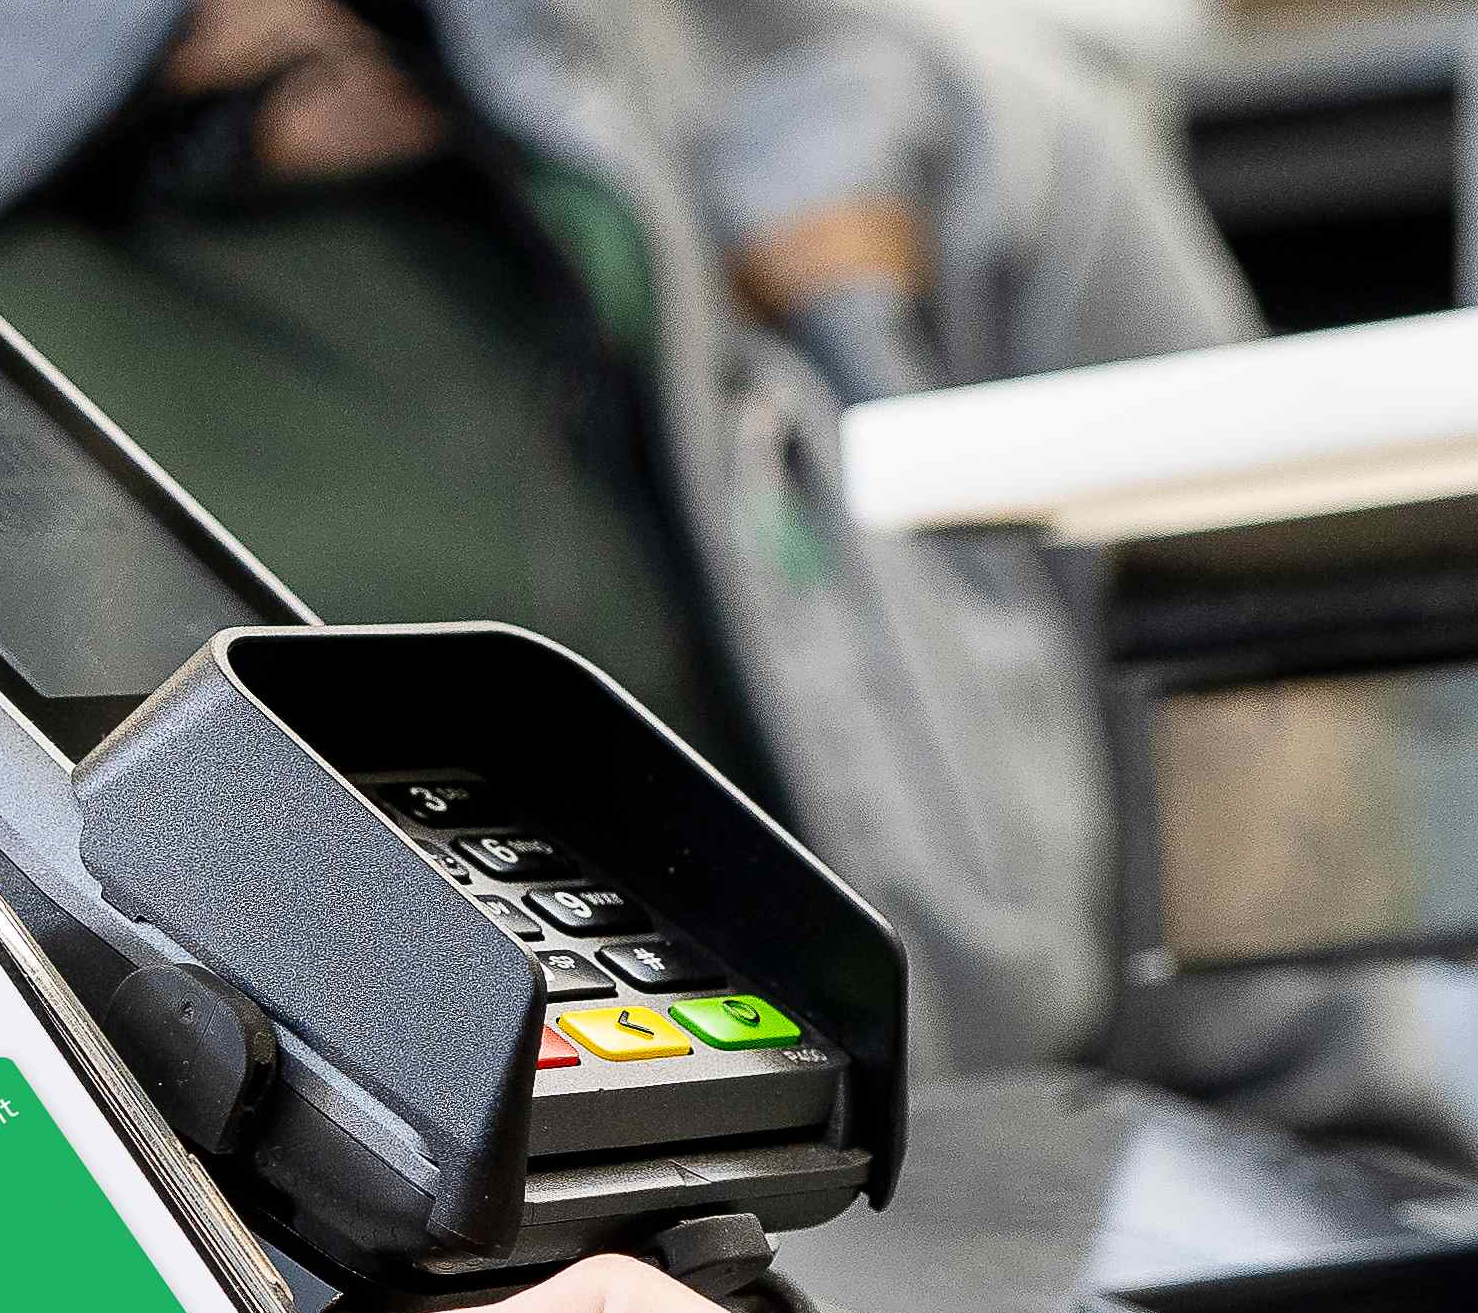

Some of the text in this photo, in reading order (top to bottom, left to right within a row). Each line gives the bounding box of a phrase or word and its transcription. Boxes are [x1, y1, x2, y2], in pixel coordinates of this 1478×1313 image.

[410, 787, 447, 812] 3
[481, 838, 519, 864] 6
[554, 891, 593, 919] 9
